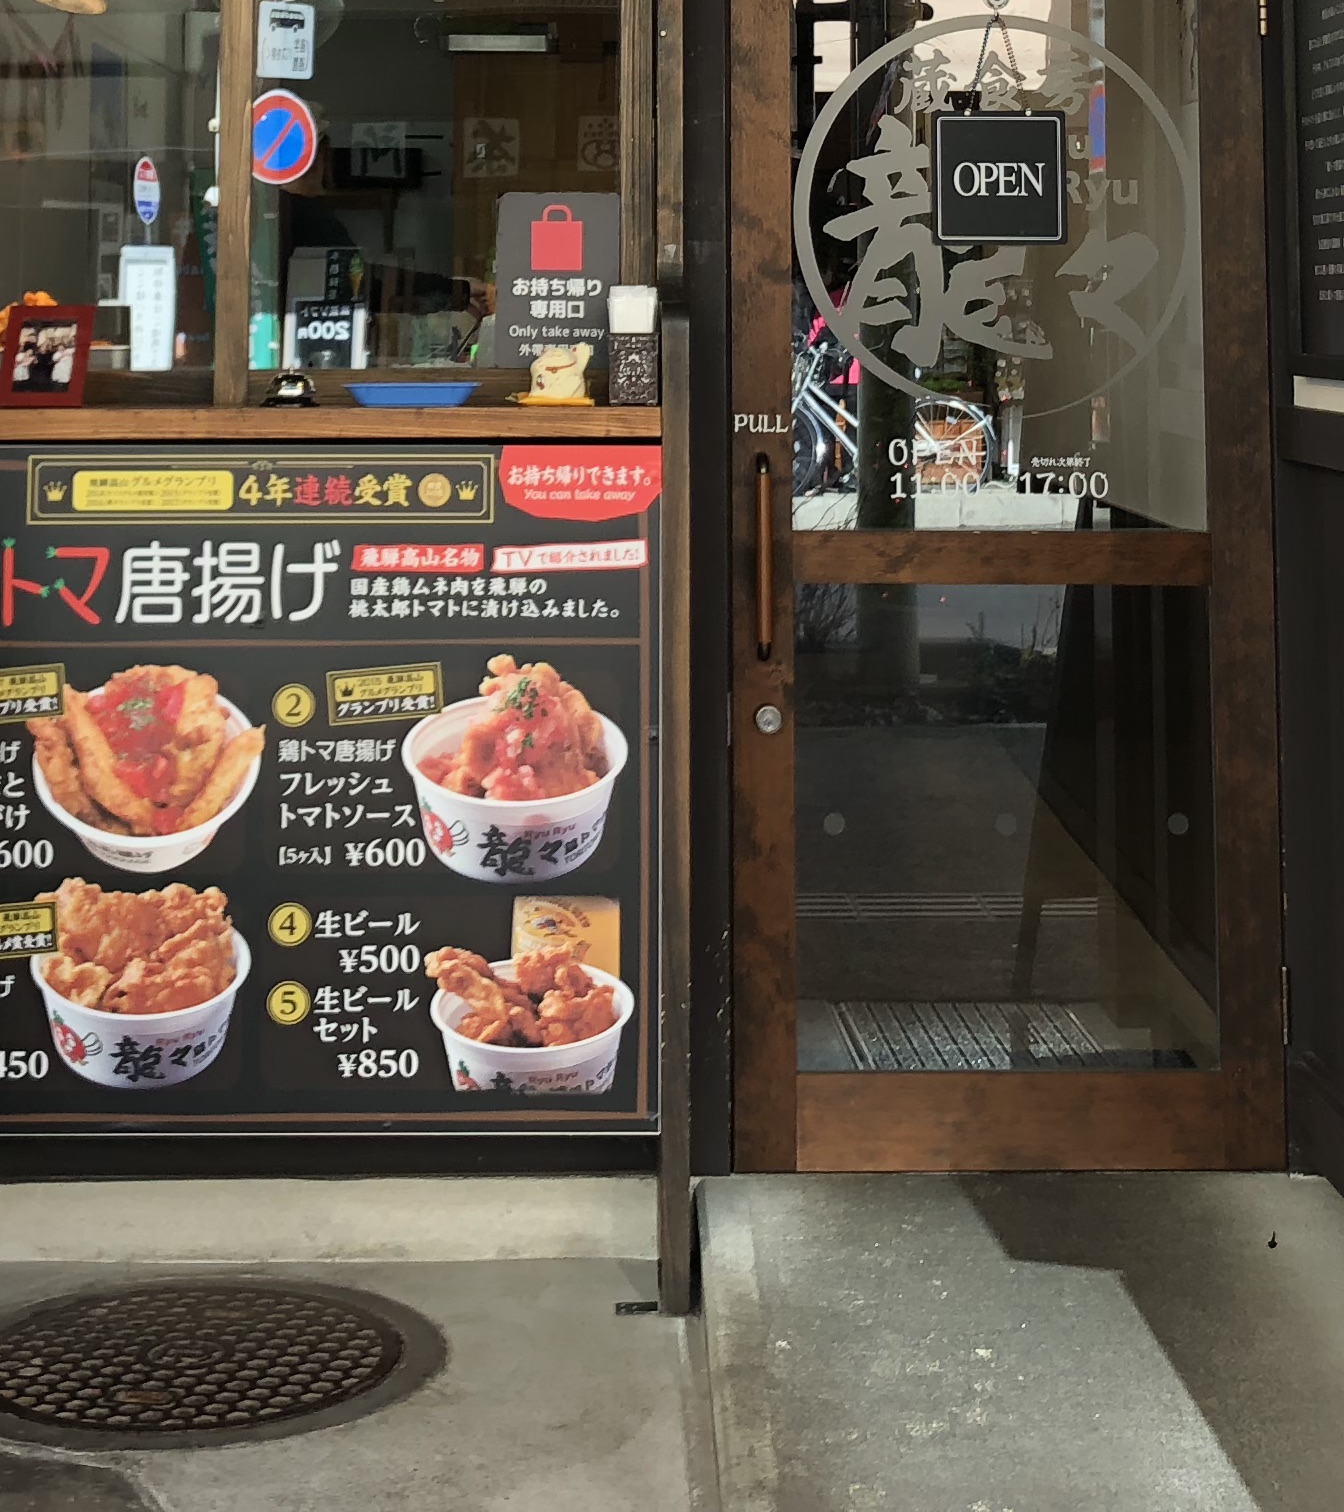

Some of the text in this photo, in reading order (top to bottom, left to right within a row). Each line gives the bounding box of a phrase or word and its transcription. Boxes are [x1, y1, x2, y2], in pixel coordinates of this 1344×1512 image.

[952, 162, 1045, 198] OPEN
[512, 277, 603, 297] お持ち帰り
[529, 300, 585, 319] 専用口
[508, 324, 605, 340] Only take away
[733, 414, 788, 434] PULL
[888, 438, 978, 466] OPEN
[238, 472, 413, 508] 4年連続受賞
[603, 490, 636, 503] away
[277, 738, 397, 763] 鶏トマ唐揚げ
[279, 772, 394, 797] フレッシュ
[278, 803, 417, 829] トマトソース
[345, 838, 426, 867] ¥600
[278, 910, 422, 940] 4 生ビール
[338, 944, 422, 975] ¥500
[279, 985, 421, 1015] 5 生ビール
[312, 1016, 379, 1044] セット
[337, 1049, 420, 1078] ¥850
